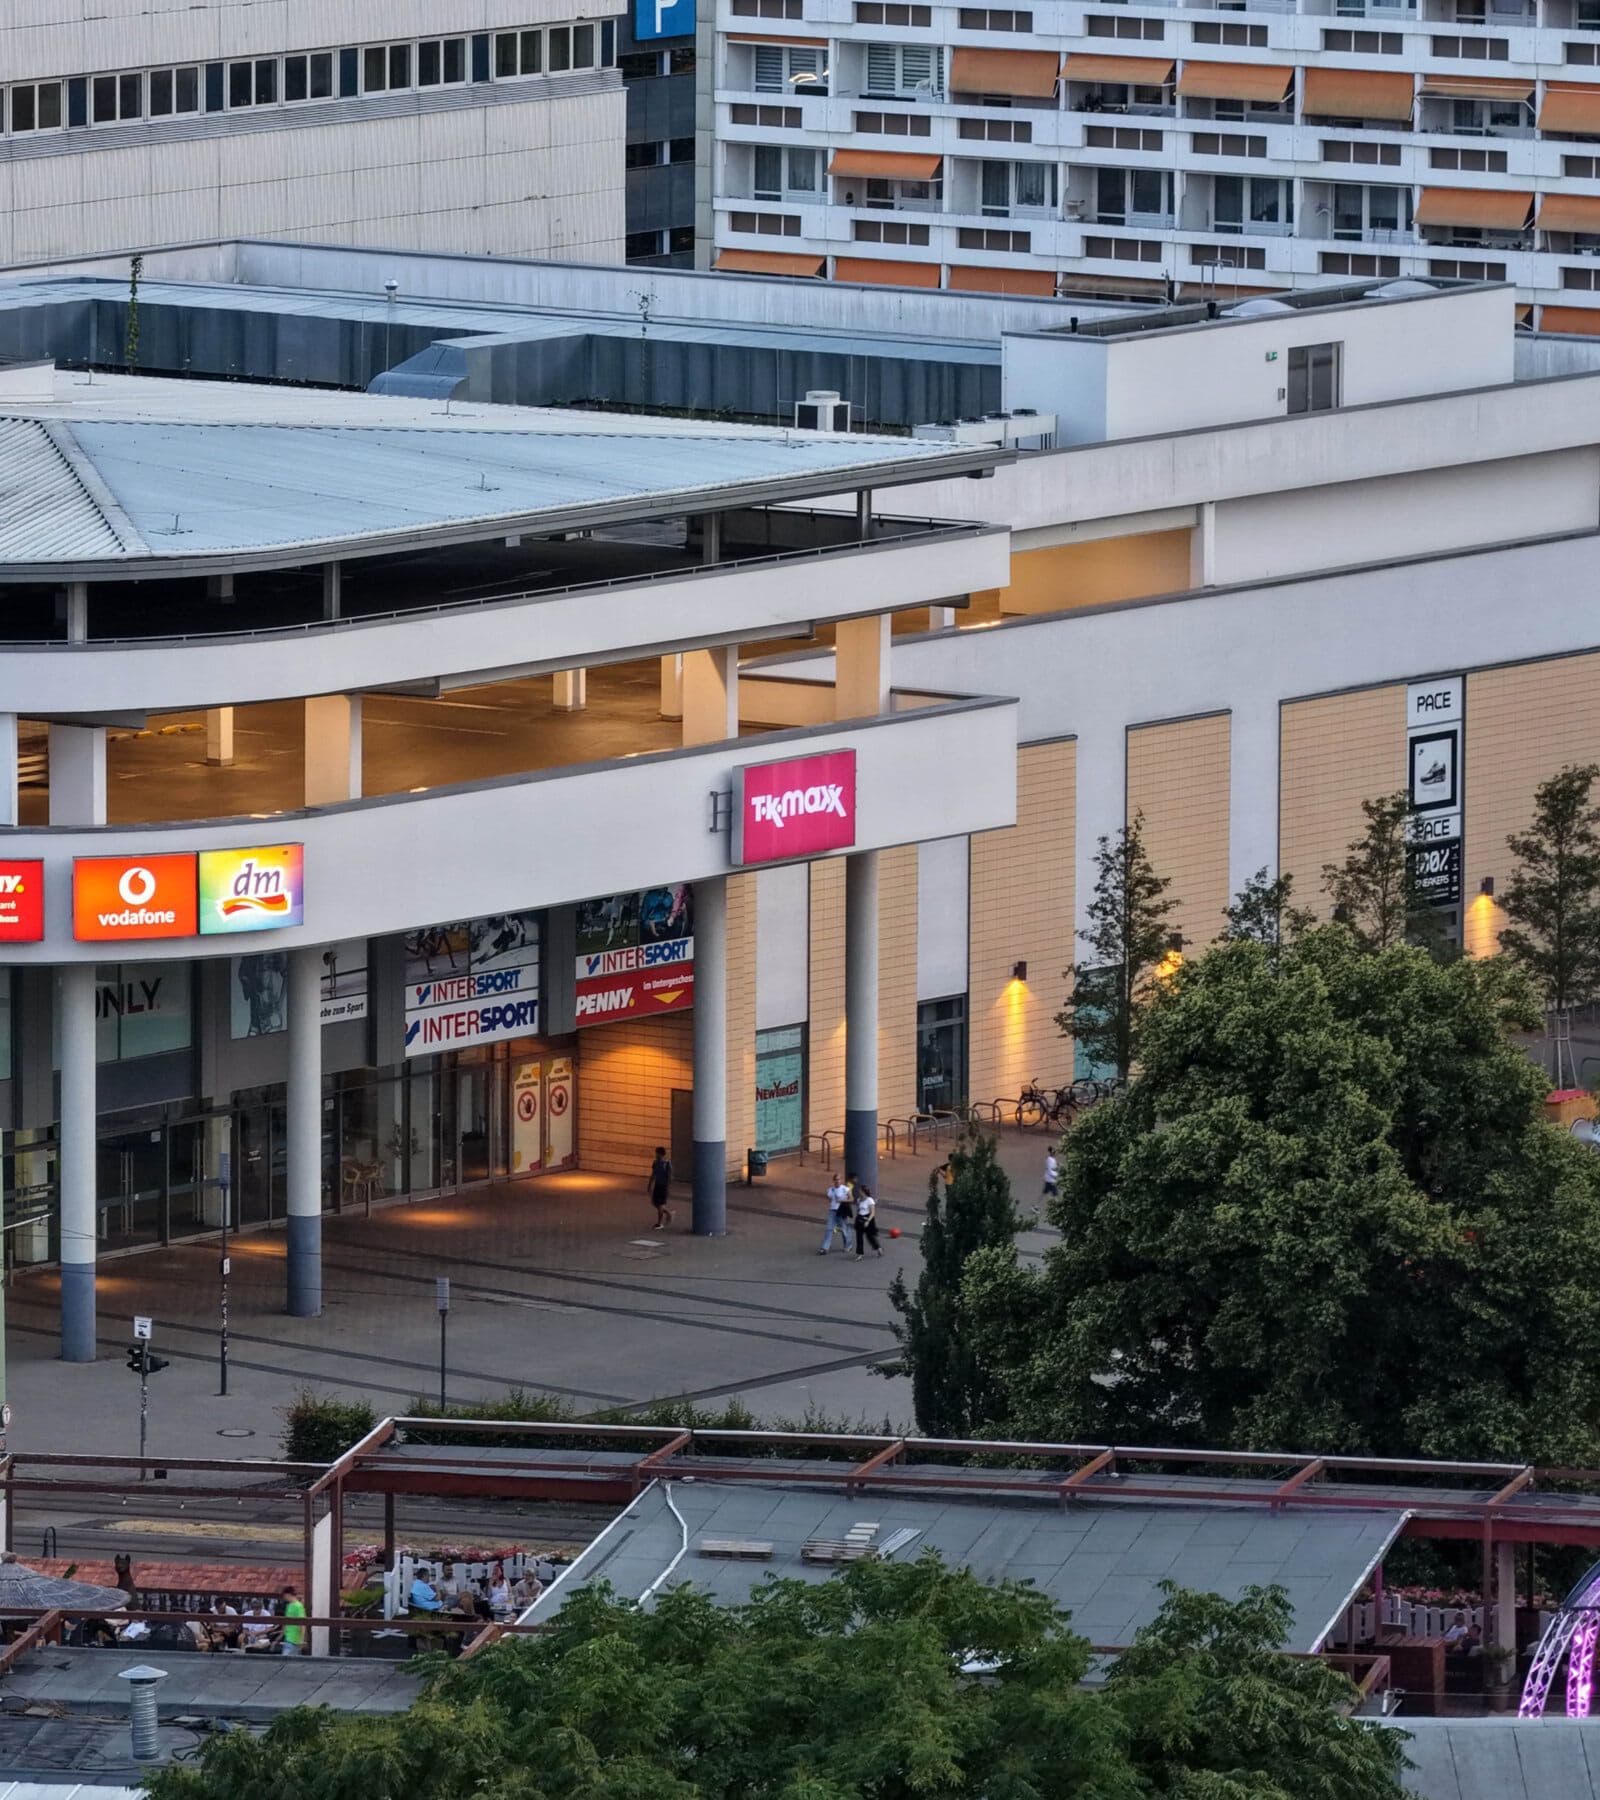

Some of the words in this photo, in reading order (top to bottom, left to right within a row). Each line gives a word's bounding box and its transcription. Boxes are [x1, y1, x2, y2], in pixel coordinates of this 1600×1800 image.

[655, 0, 679, 33] P
[1417, 691, 1451, 713] PACE
[1416, 818, 1450, 840] PACE
[233, 862, 281, 897] dm
[98, 907, 176, 927] vodafone
[602, 939, 689, 973] INTERSPORT
[96, 977, 162, 1018] NLY
[432, 969, 522, 1003] INTERSPORT
[346, 1002, 364, 1015] Sport
[423, 998, 538, 1044] INTERSPORT
